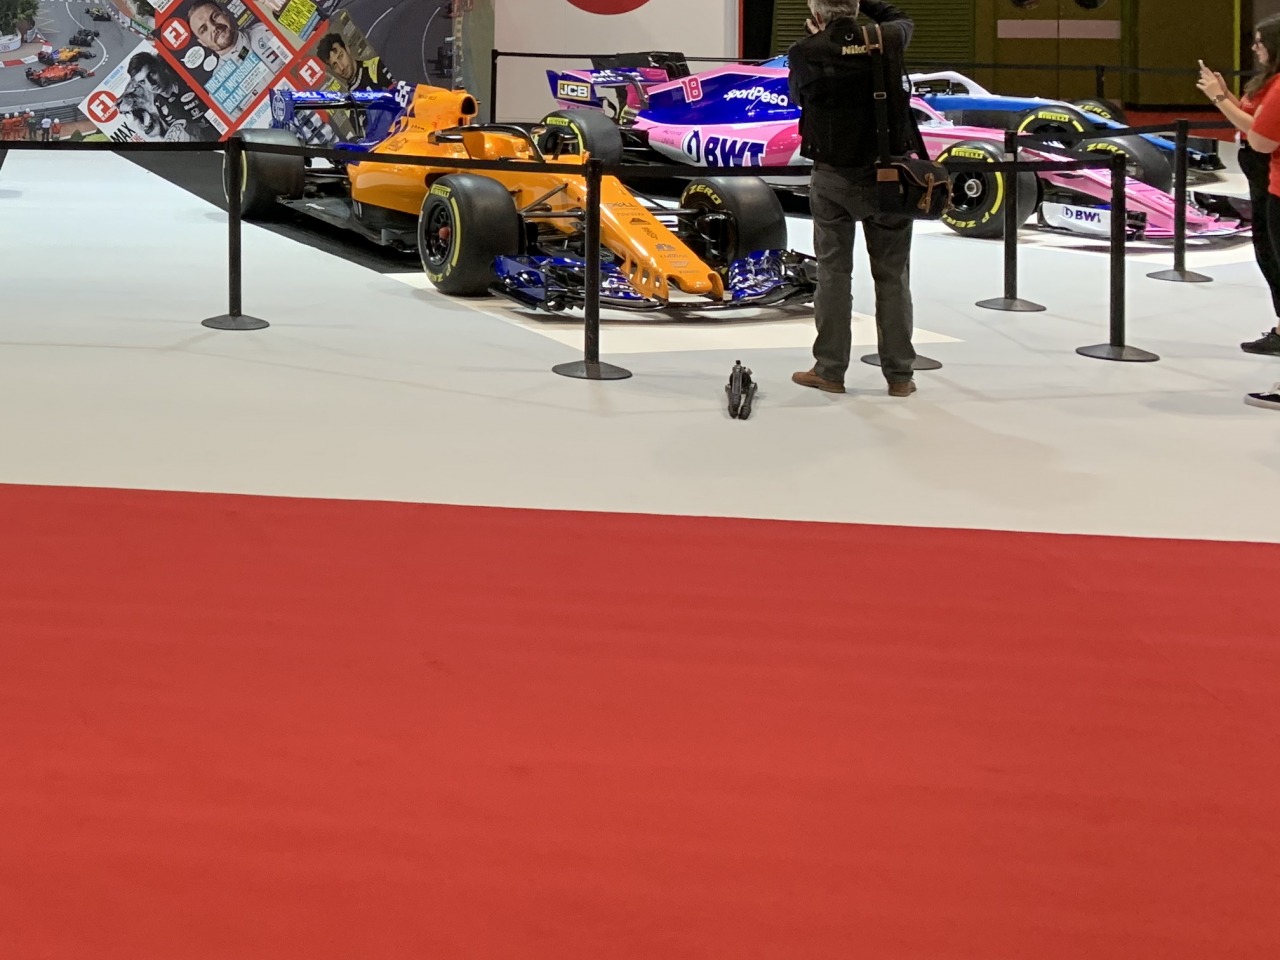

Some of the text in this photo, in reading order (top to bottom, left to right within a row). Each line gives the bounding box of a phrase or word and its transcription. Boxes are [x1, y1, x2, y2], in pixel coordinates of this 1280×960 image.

[163, 20, 187, 47] F1
[204, 59, 237, 94] DREAMING
[213, 86, 229, 102] THE
[223, 53, 259, 91] IMPOSSIBLE
[299, 59, 322, 85] F1
[221, 86, 246, 112] DREAM
[560, 84, 588, 98] JCB
[681, 77, 704, 103] 18
[90, 93, 114, 120] F1
[1038, 111, 1070, 122] PIRELLI
[110, 122, 136, 142] MAX
[704, 136, 767, 167] BWT
[951, 147, 985, 160] PIRELLI
[689, 184, 723, 206] ZERO
